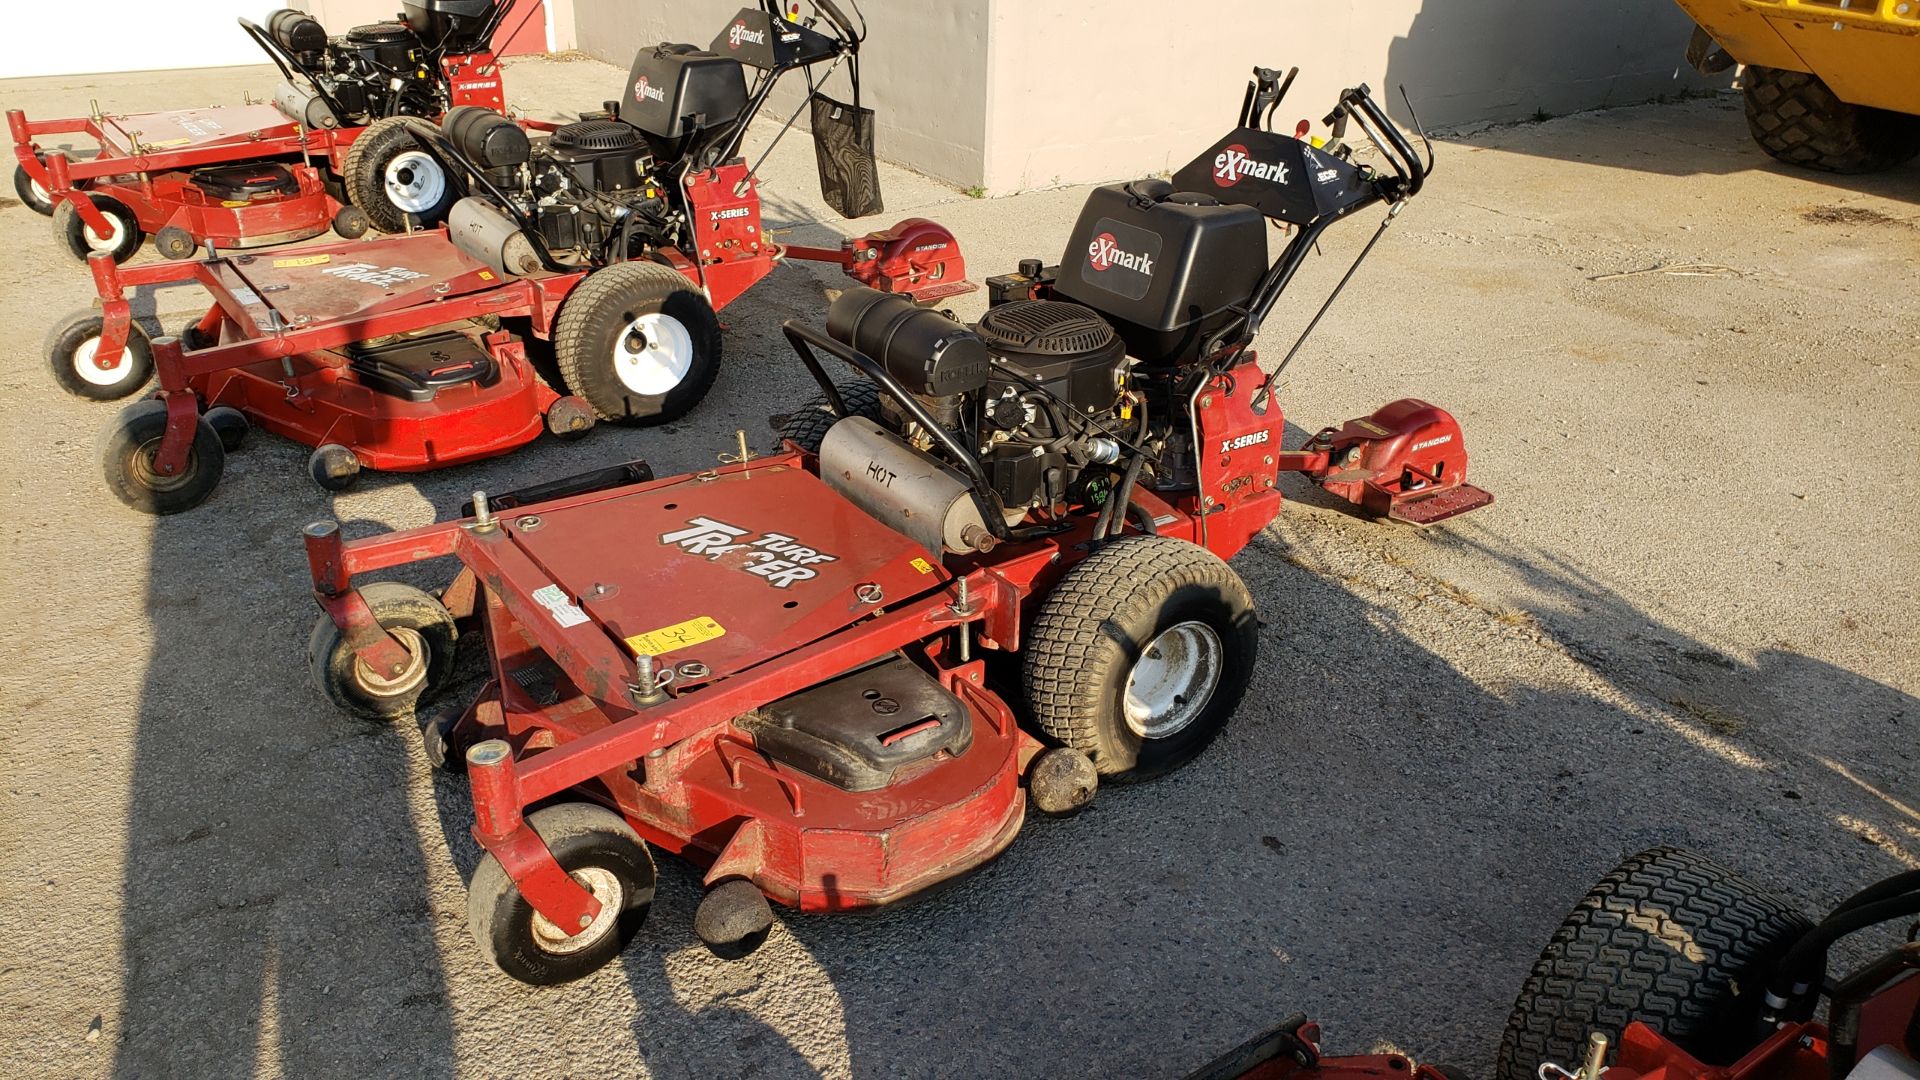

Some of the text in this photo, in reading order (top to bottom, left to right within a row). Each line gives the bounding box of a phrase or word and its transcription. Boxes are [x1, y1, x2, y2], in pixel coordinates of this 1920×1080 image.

[729, 24, 765, 45] eXmark
[634, 79, 664, 102] eXmark
[1214, 149, 1290, 185] eXmark
[710, 207, 750, 221] X-SERIES
[1088, 237, 1154, 276] eXmark
[1220, 430, 1269, 453] X-SERIES
[1411, 433, 1453, 452] STANDON
[866, 461, 897, 488] HOT
[750, 532, 840, 566] TURF
